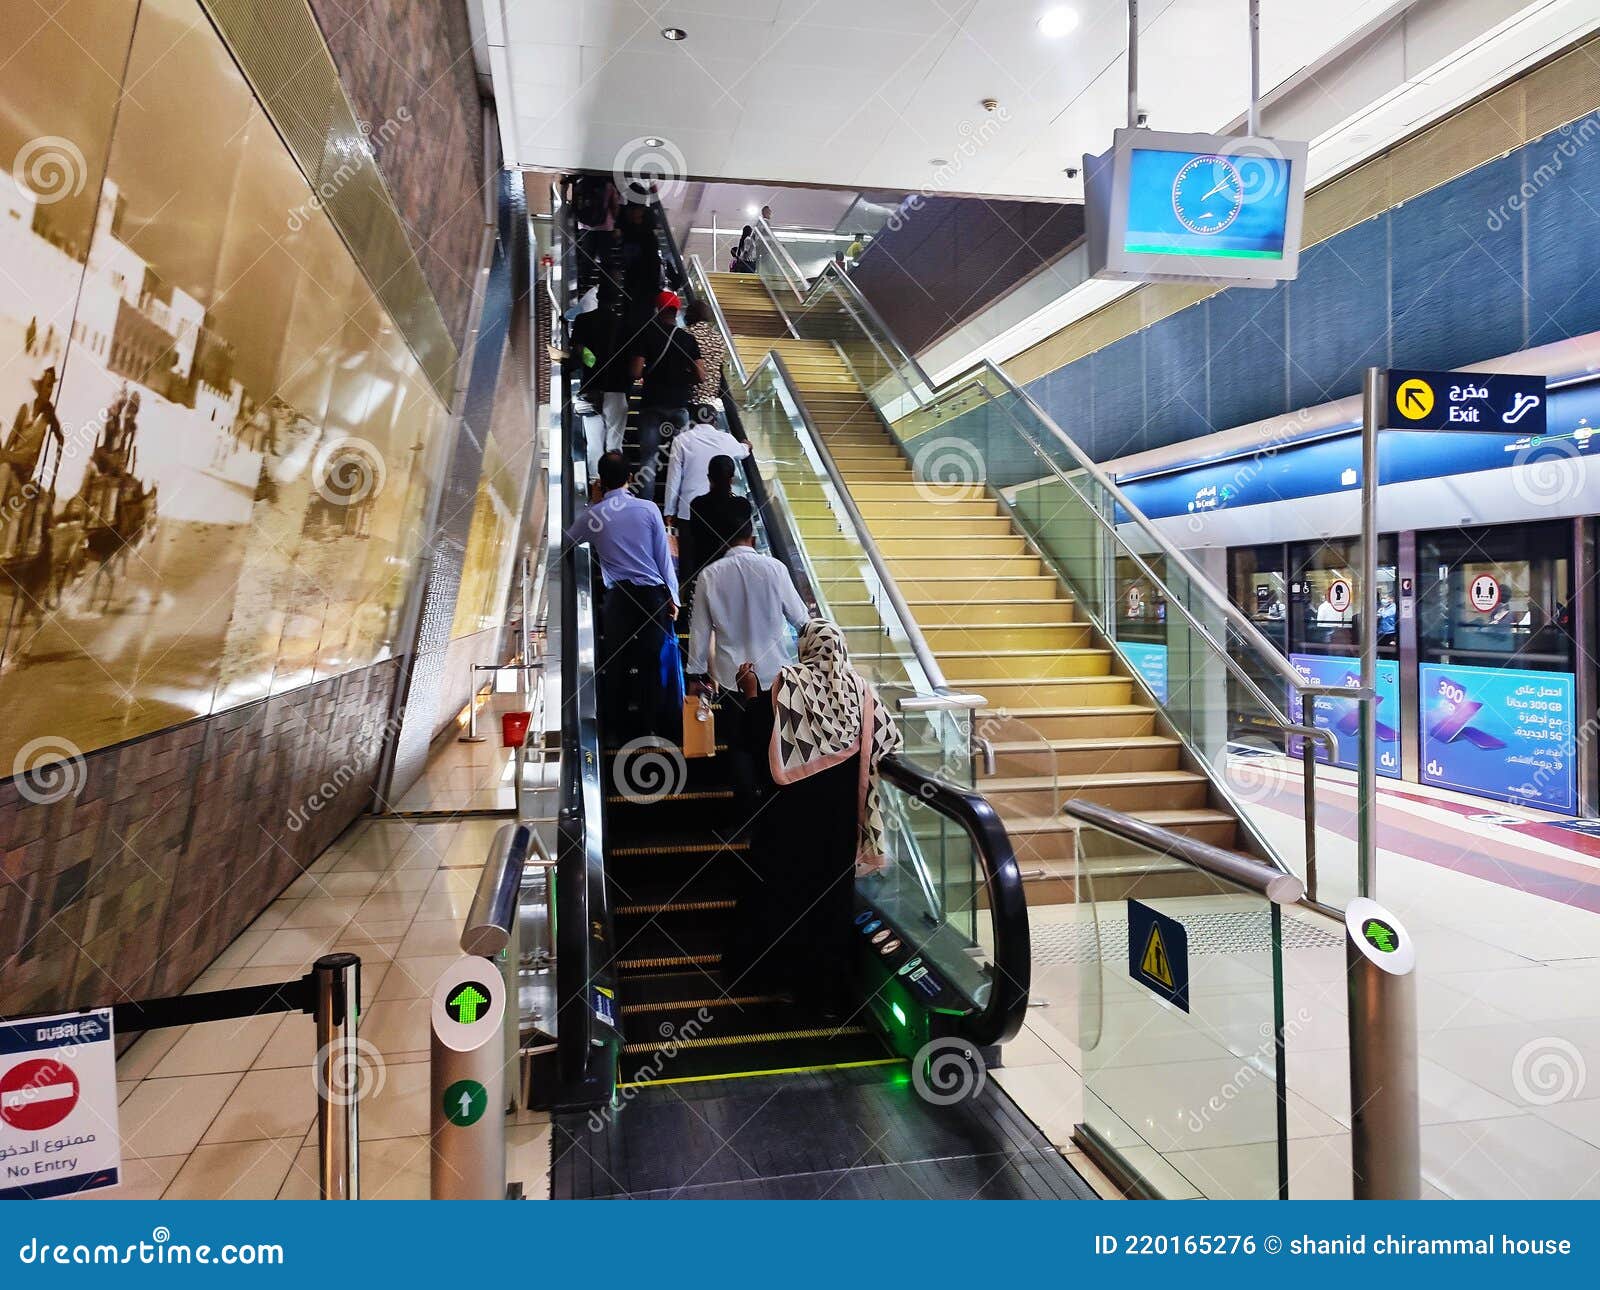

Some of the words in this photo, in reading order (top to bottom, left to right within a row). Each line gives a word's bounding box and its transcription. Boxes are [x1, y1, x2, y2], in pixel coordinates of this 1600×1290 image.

[1449, 384, 1489, 402] مخرج
[1449, 406, 1480, 422] Exit
[1438, 681, 1464, 704] 300
[1529, 700, 1548, 711] 300
[1548, 702, 1562, 712] GB
[1550, 731, 1562, 741] 5G
[1427, 760, 1443, 776] du
[0, 1140, 39, 1160] الدخو
[44, 1134, 96, 1153] ممنوع
[8, 1166, 30, 1178] No
[35, 1158, 78, 1174] Entry
